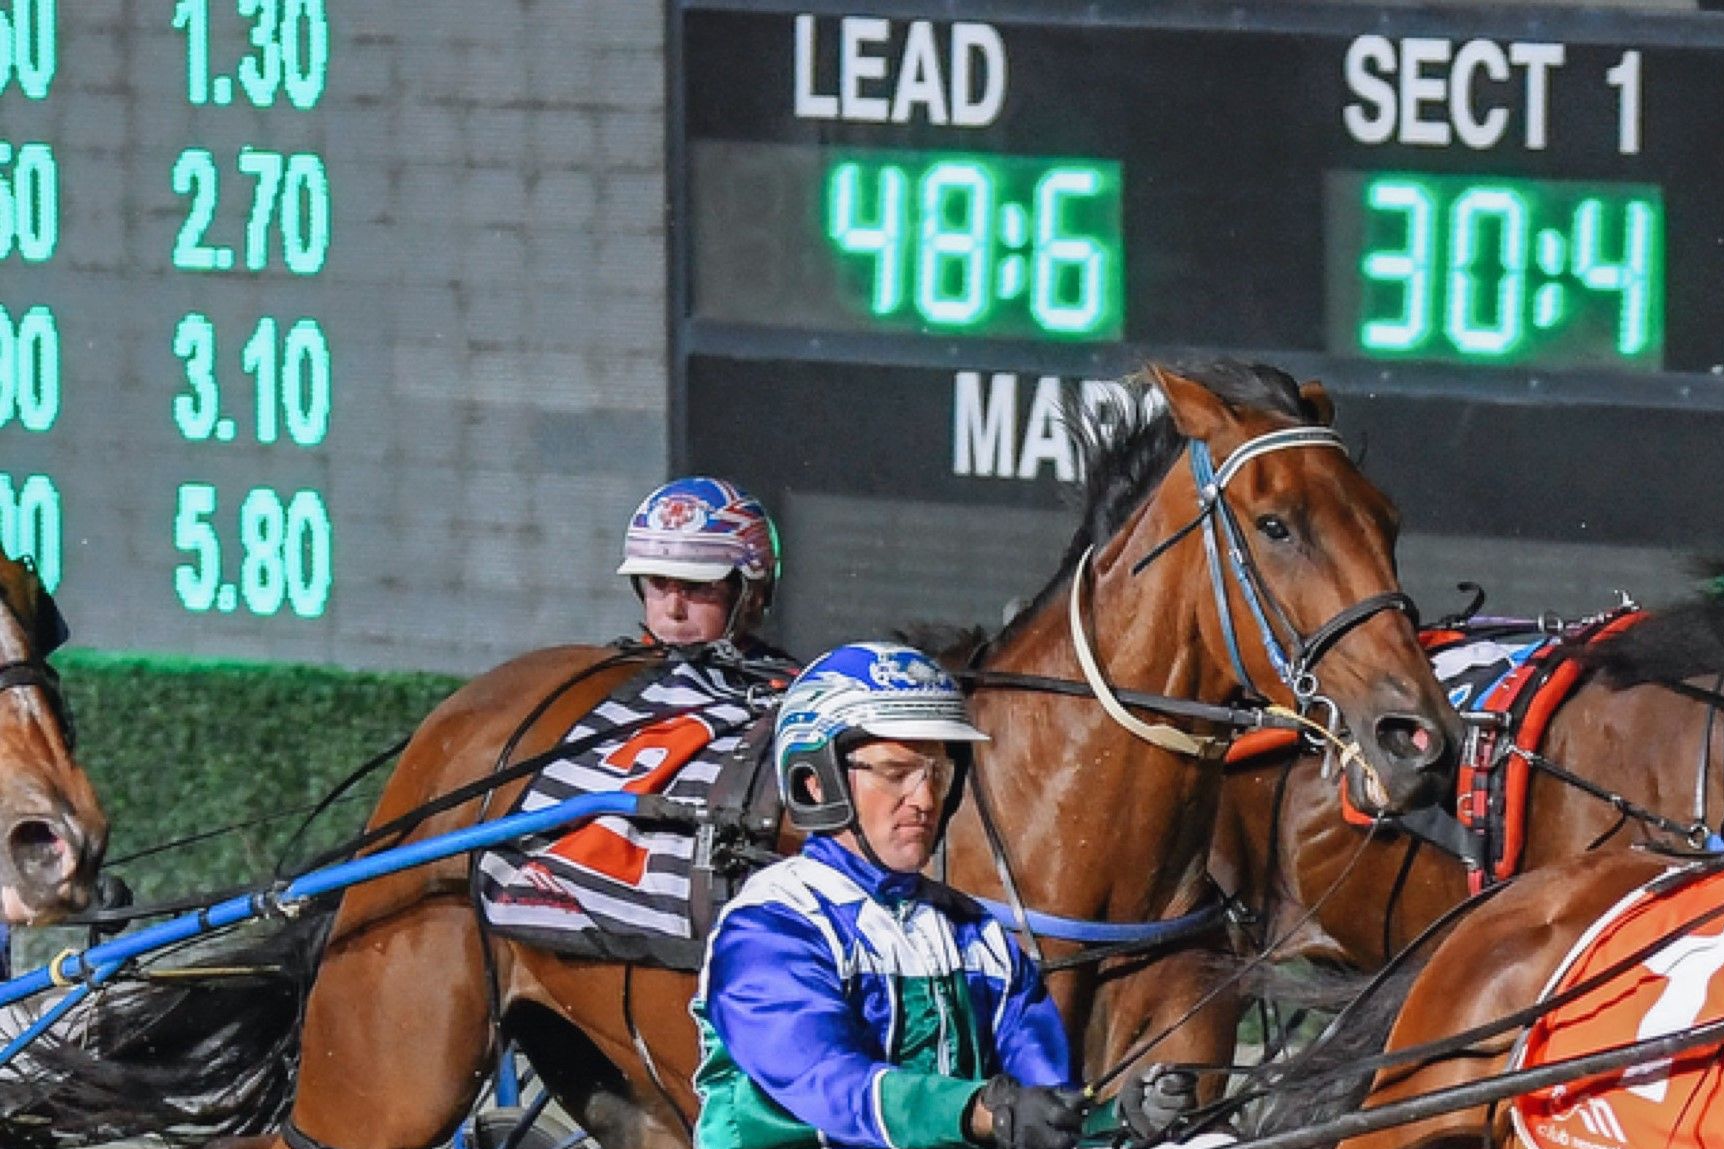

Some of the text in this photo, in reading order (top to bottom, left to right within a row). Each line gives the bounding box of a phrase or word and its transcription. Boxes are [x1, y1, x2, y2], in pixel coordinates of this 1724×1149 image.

[171, 0, 329, 109] 1.30
[795, 15, 1005, 125] LEAD
[1344, 34, 1640, 153] SECT 1
[173, 145, 330, 274] 2.70
[827, 158, 1112, 333] 48:6
[1361, 180, 1655, 356] 30:4
[174, 313, 331, 446] 3.10
[175, 484, 332, 618] 5.80
[547, 713, 713, 887] 2
